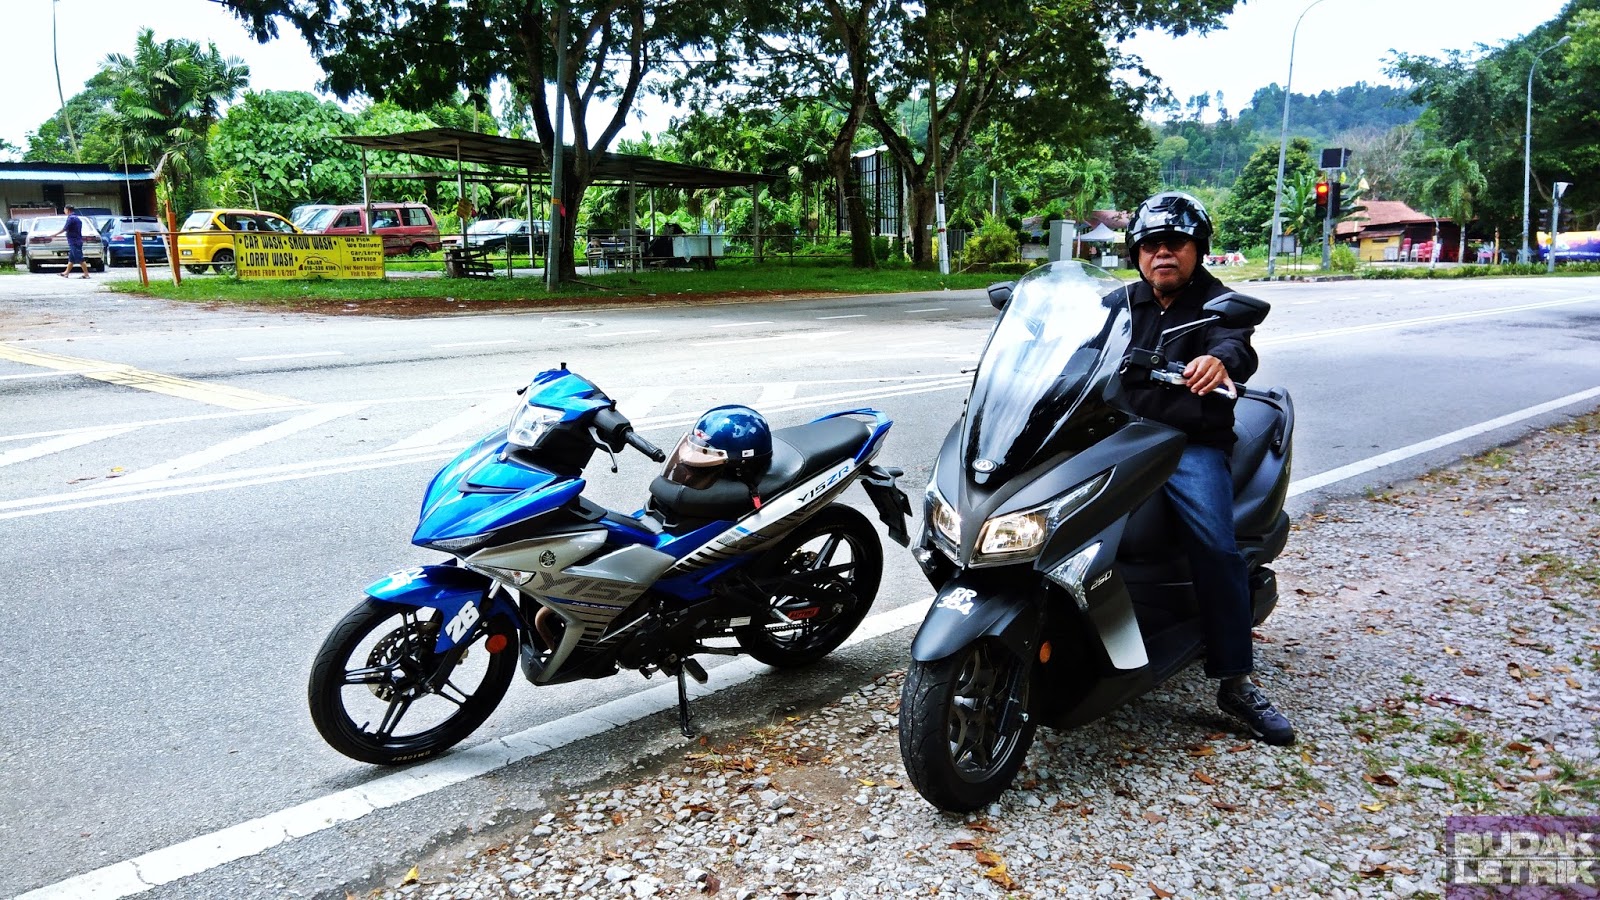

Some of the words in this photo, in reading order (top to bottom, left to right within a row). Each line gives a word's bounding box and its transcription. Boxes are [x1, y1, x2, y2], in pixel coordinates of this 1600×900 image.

[243, 235, 260, 249] CAR
[261, 236, 284, 250] WASH
[288, 236, 310, 250] SNOW
[311, 236, 334, 250] WASH
[245, 252, 269, 267] LORRY
[272, 252, 294, 267] WASH
[797, 465, 850, 503] Y15ZR
[1090, 569, 1113, 591] 250
[951, 587, 978, 602] RR
[444, 600, 480, 645] 26
